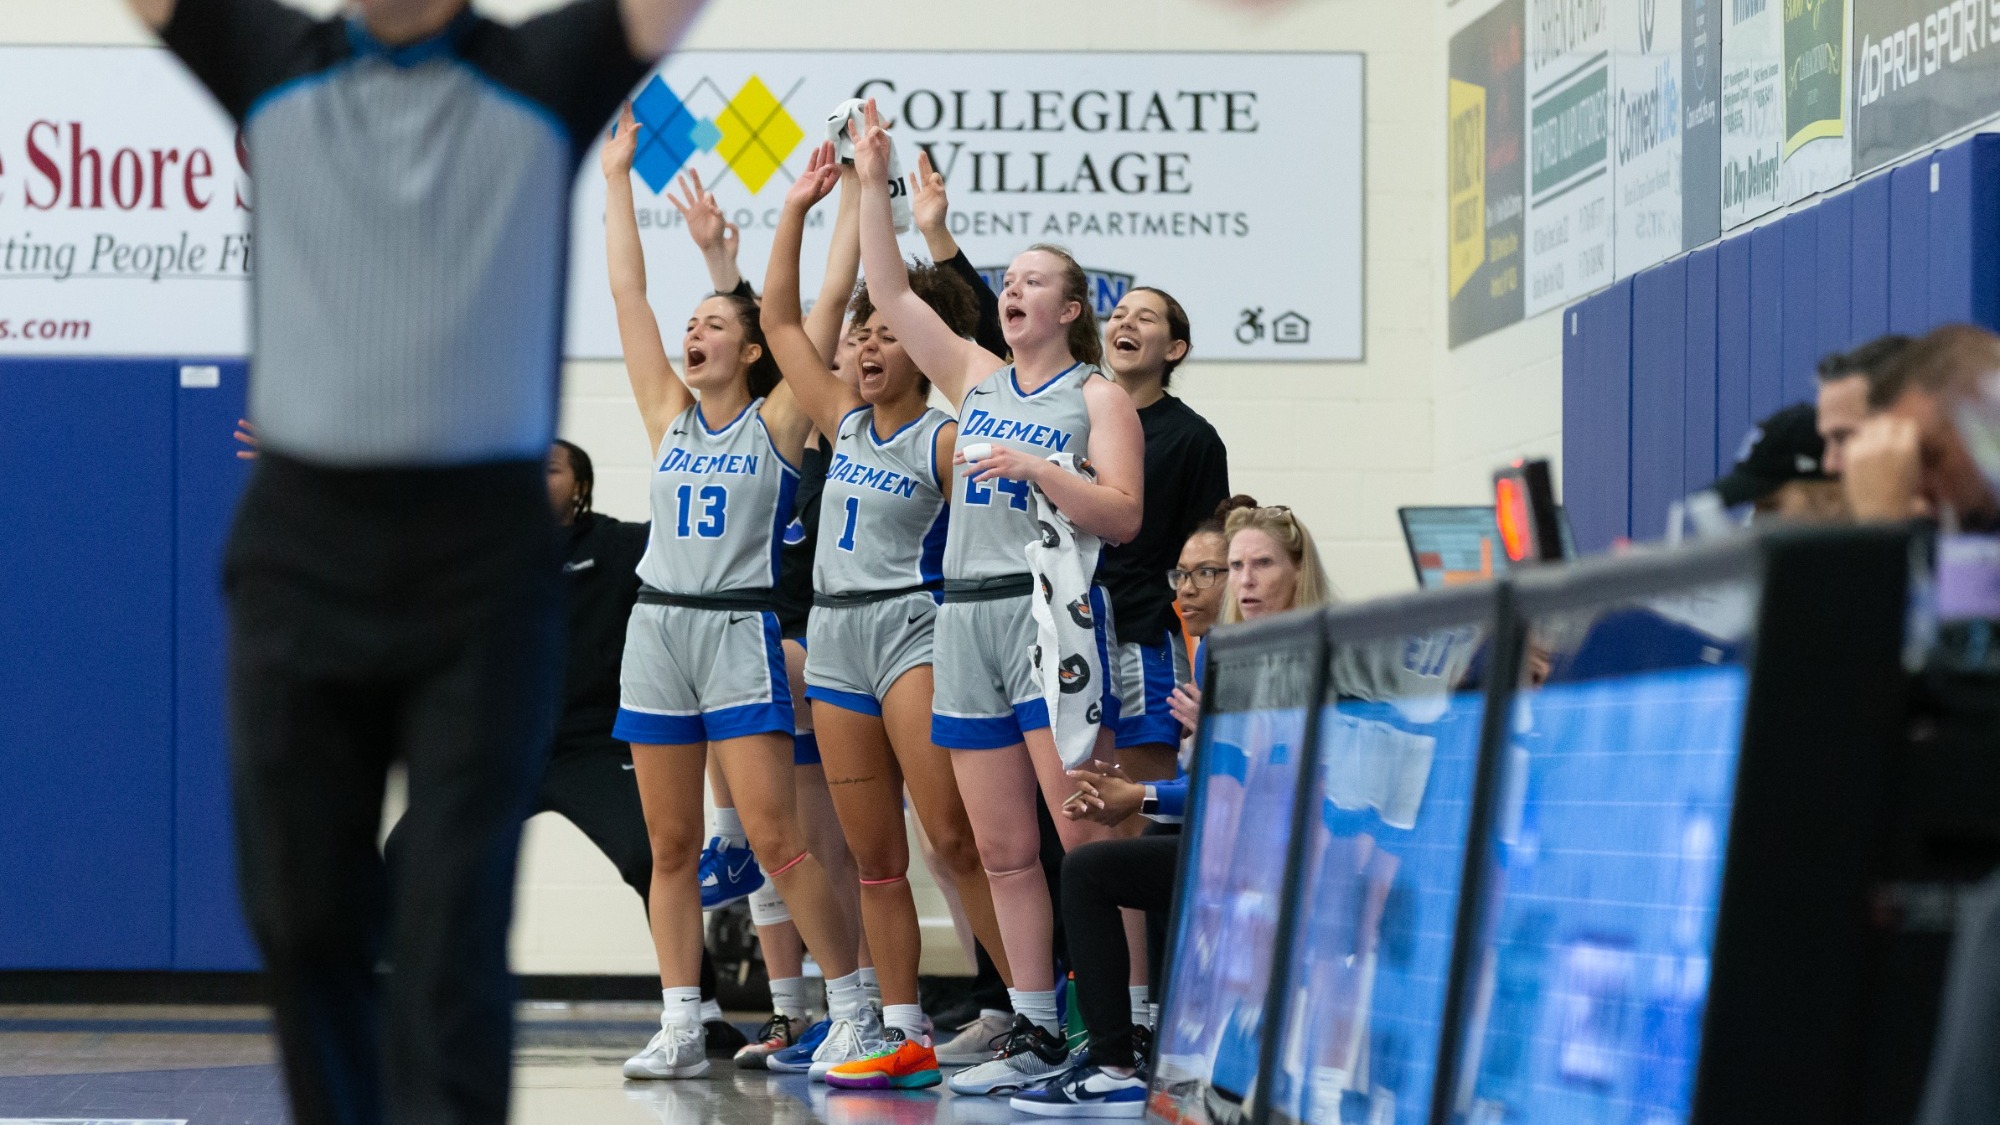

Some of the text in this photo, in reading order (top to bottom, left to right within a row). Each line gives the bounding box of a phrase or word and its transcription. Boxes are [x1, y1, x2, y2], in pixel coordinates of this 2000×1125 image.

[24, 118, 214, 212] Shore
[914, 141, 1193, 195] VILLAGE
[1041, 210, 1250, 238] APARTMENTS
[1, 230, 77, 282] ting
[89, 230, 206, 282] People
[959, 408, 1073, 454] DAEMEN
[658, 447, 760, 476] DAEMEN
[675, 484, 729, 539] 13
[837, 496, 860, 553] 1
